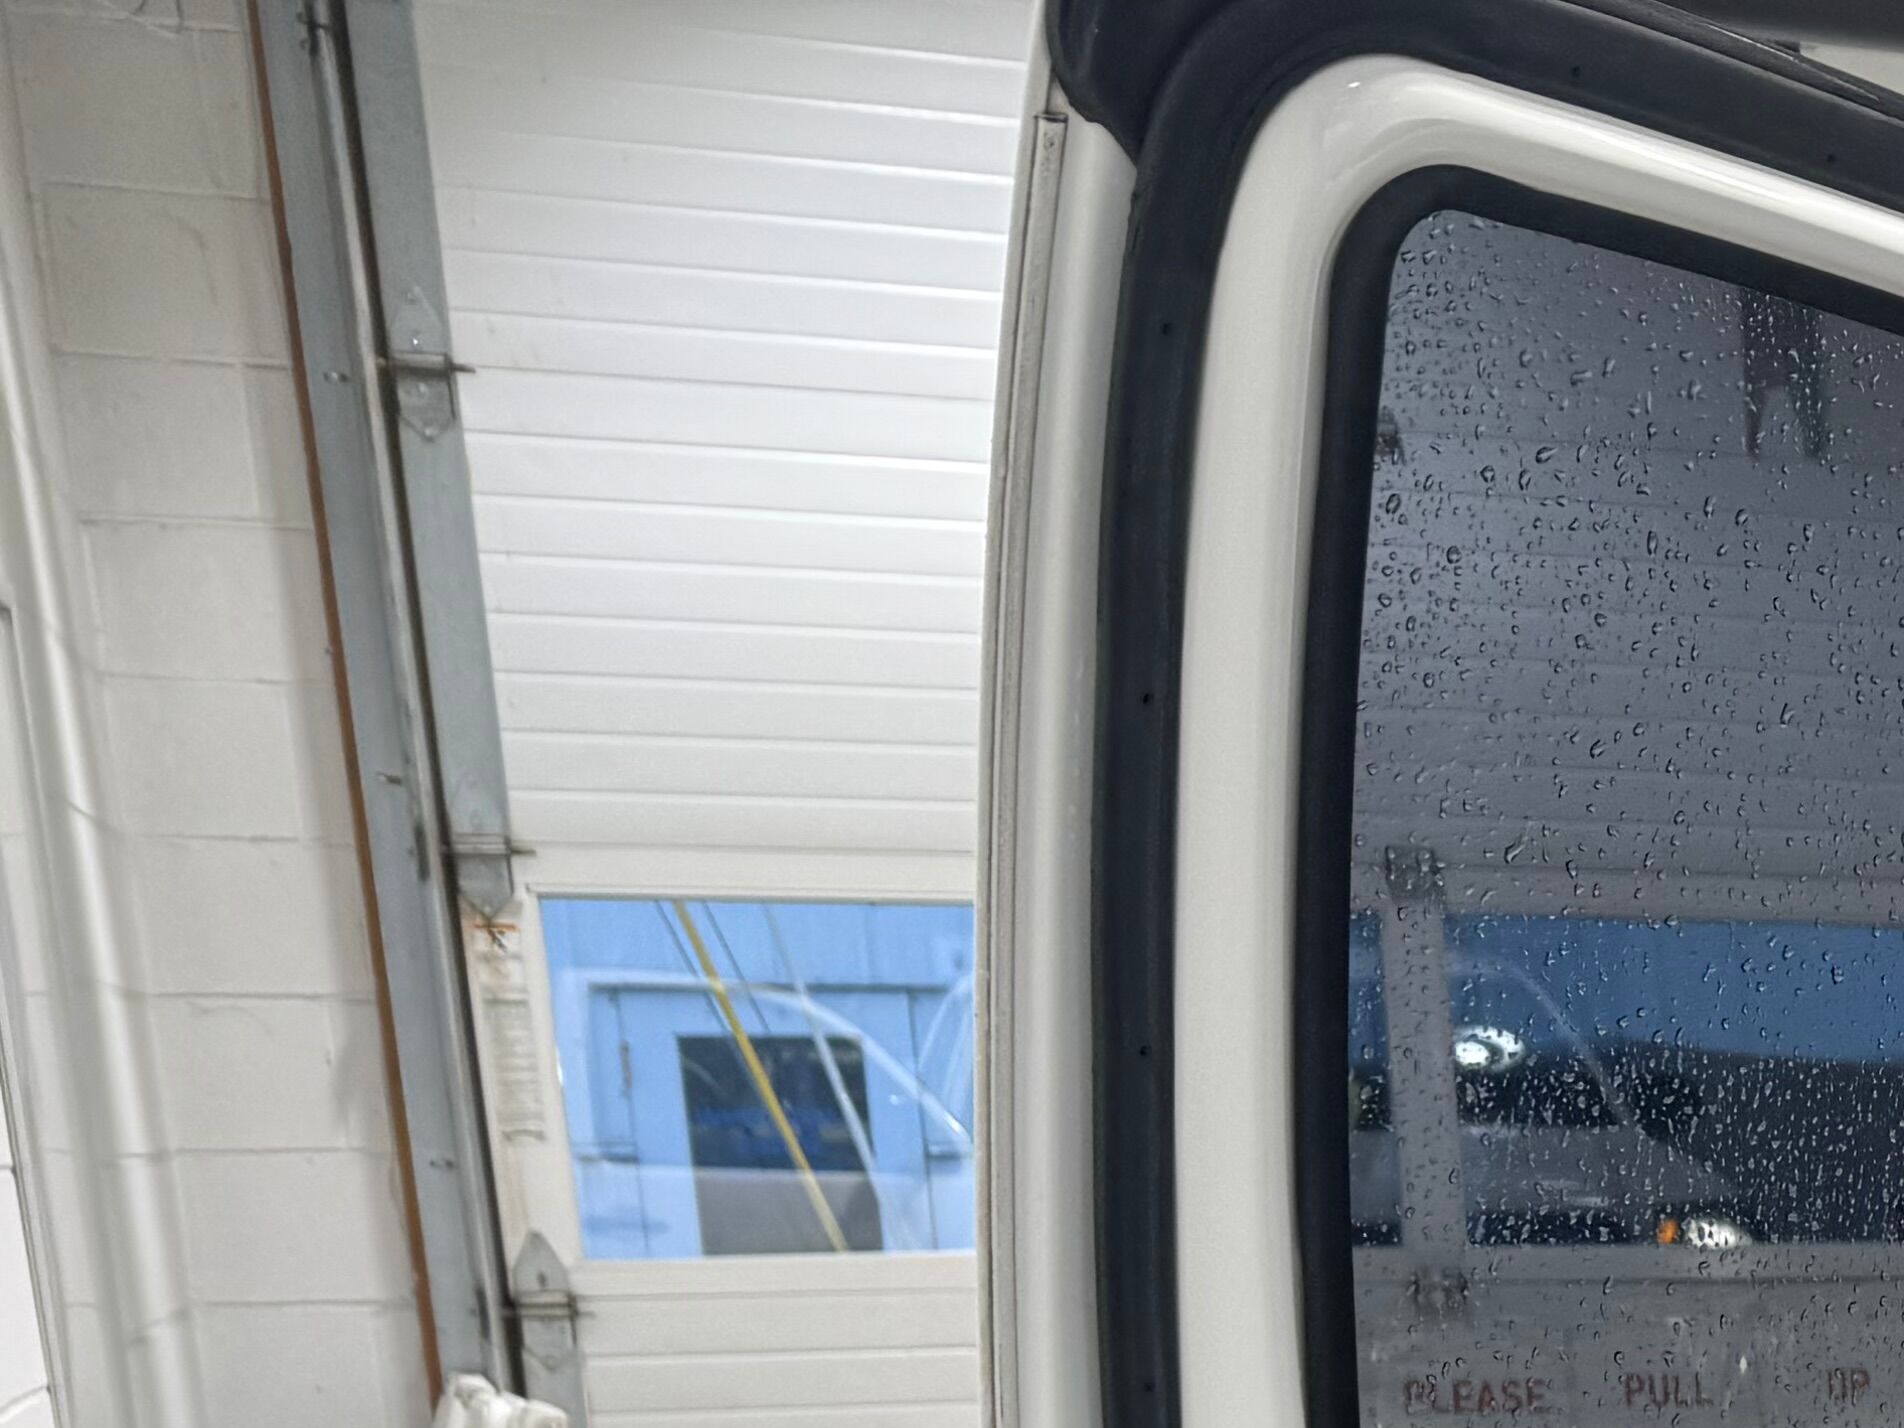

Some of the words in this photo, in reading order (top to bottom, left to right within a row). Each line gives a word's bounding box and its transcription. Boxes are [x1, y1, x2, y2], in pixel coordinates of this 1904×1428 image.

[1404, 1375, 1551, 1414] PLEASE
[1623, 1372, 1713, 1407] PULL
[1826, 1367, 1870, 1406] UP
